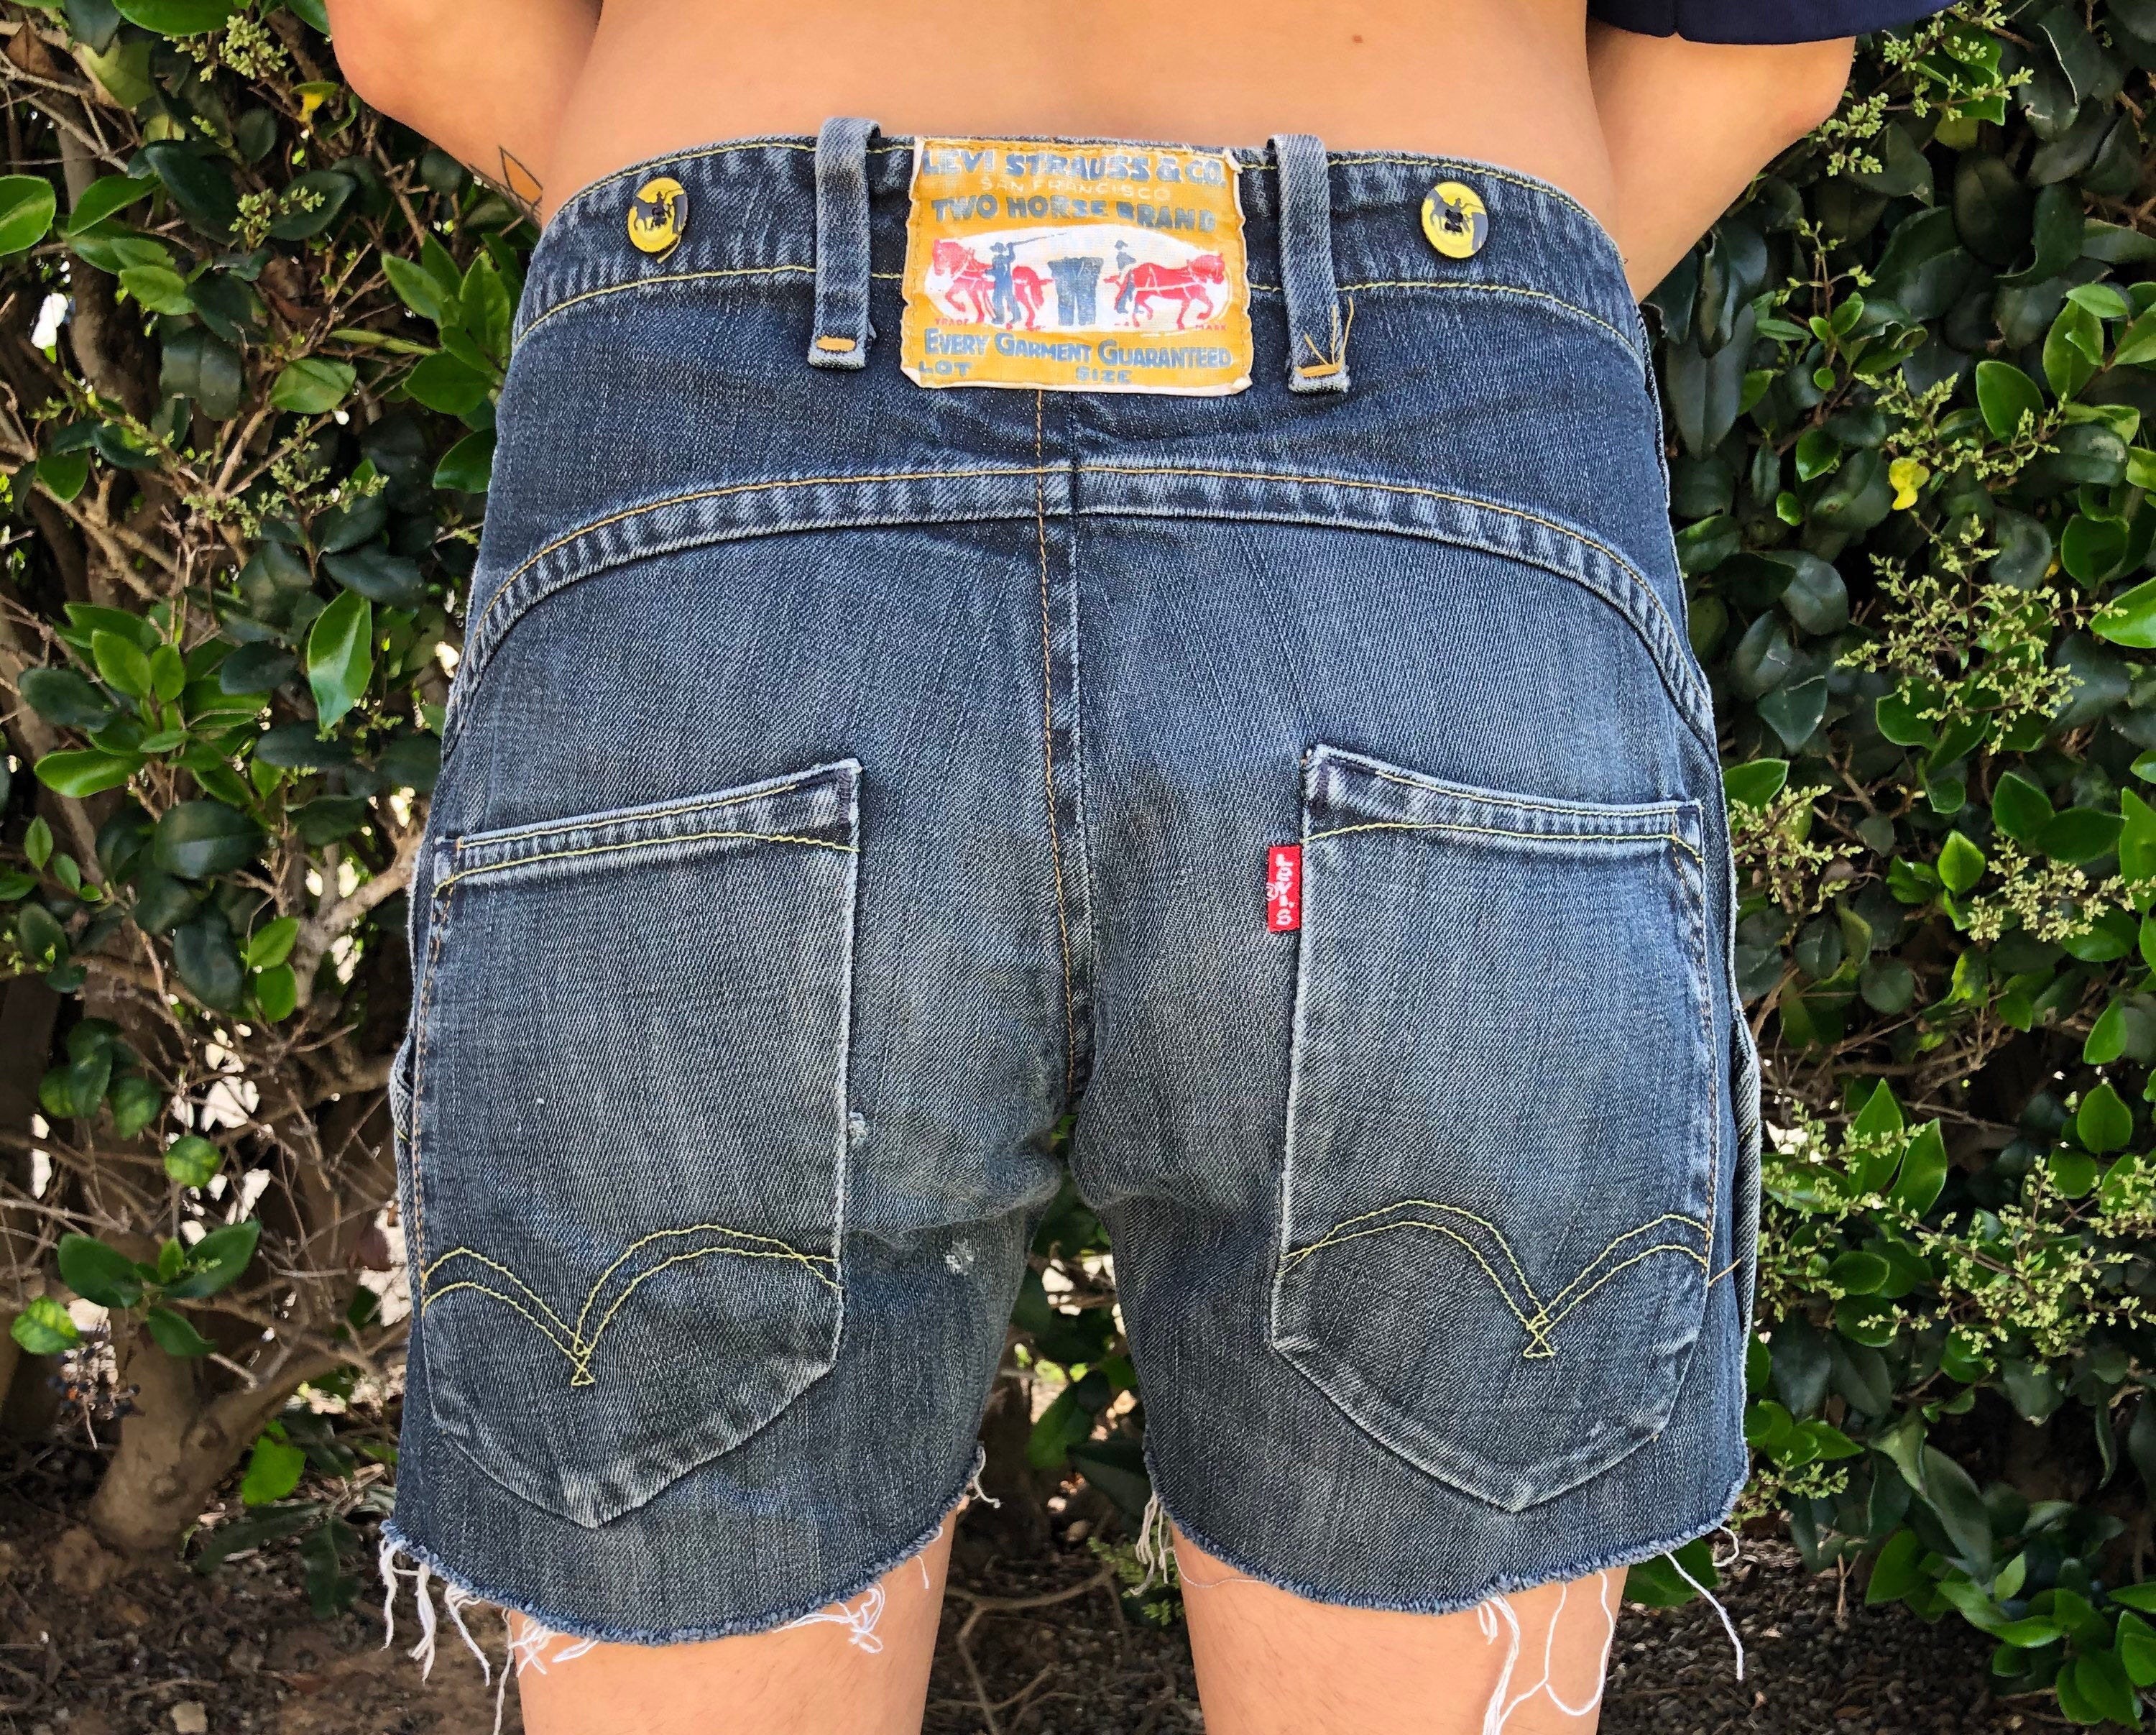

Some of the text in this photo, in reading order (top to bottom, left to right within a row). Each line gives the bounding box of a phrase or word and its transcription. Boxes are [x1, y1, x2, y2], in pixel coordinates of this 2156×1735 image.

[1006, 152, 1150, 183] STRAUSS
[1156, 157, 1181, 183] &
[931, 194, 1216, 233] TWO HORSE BRAND
[918, 360, 972, 377] LOT
[1075, 365, 1133, 384] SIZE
